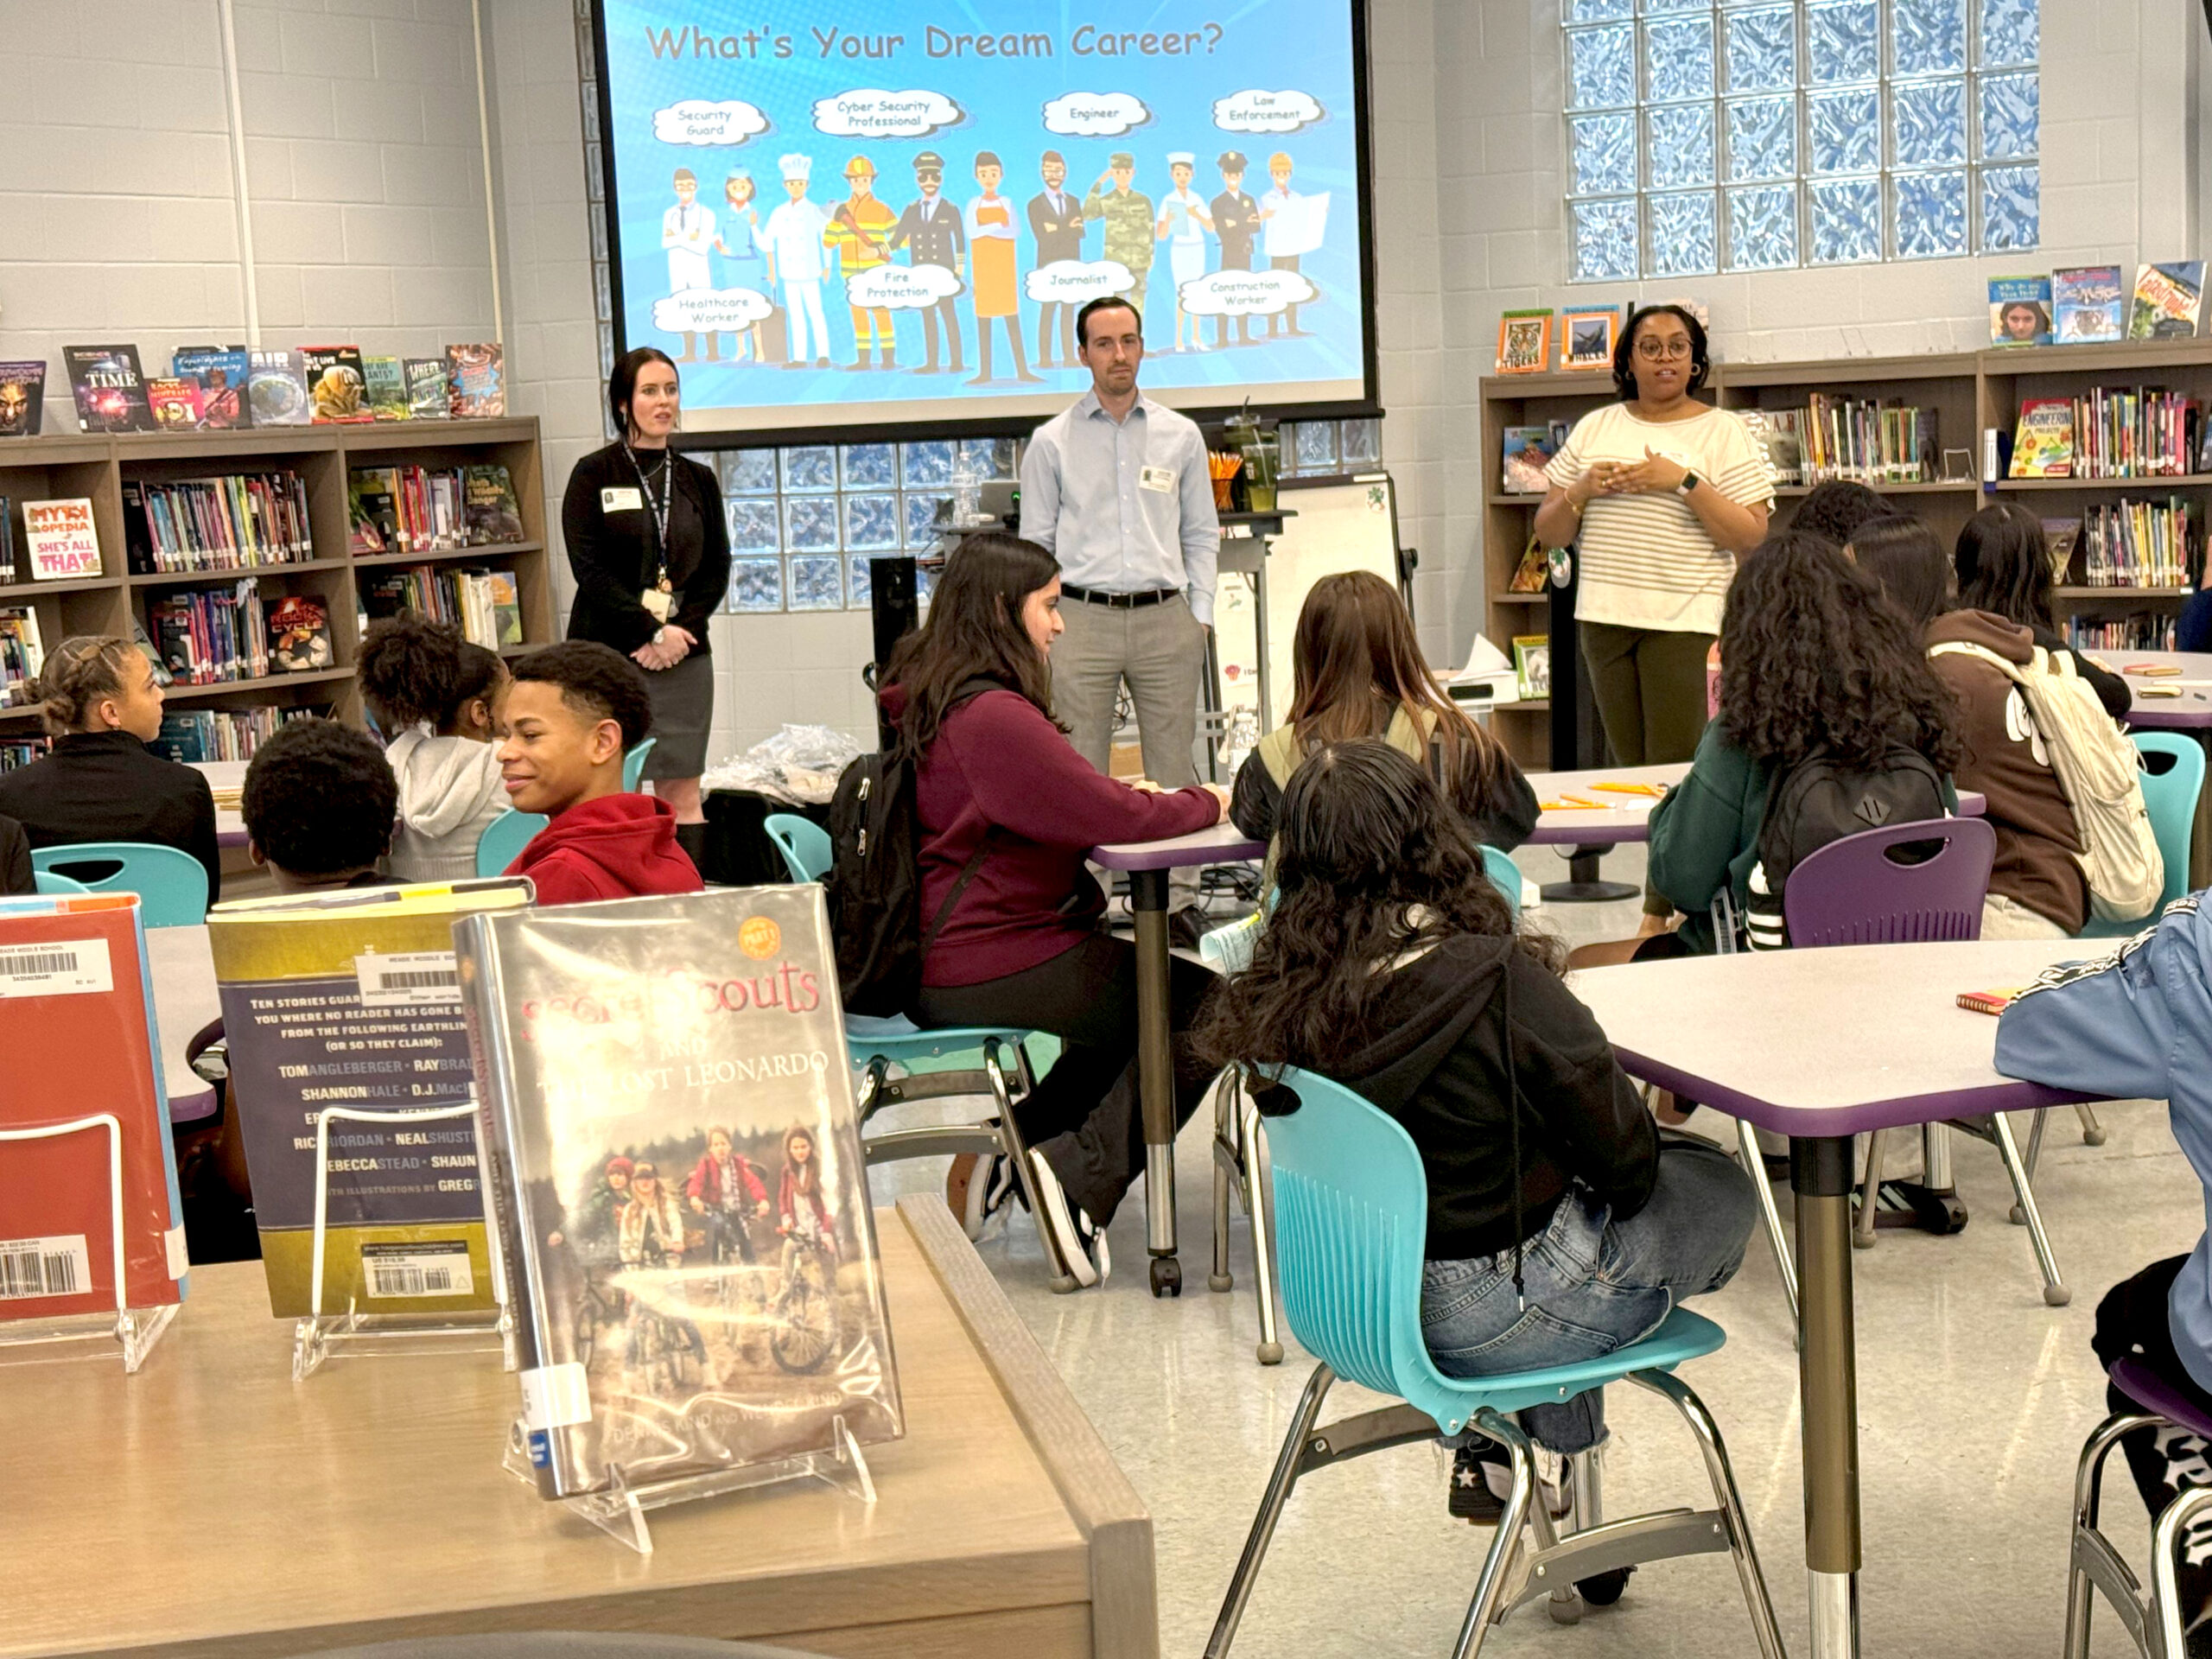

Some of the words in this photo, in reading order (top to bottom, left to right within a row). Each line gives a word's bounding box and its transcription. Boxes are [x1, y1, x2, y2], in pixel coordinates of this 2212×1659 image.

[645, 24, 793, 60] What's
[810, 25, 906, 59] Your
[925, 24, 1053, 58] Dream
[1071, 22, 1224, 56] Career?
[836, 100, 874, 114] Cyber
[878, 100, 931, 113] Security
[1253, 95, 1275, 106] Law
[677, 109, 732, 124] Security
[848, 115, 921, 127] Professional
[1069, 108, 1121, 121] Engineer
[1228, 109, 1300, 121] Enforcement
[686, 124, 725, 136] Guard
[884, 271, 909, 283] Fire
[1050, 274, 1108, 285] Journalist
[867, 286, 929, 298] Protection
[1210, 280, 1281, 293] Construction
[678, 296, 749, 309] Healthcare
[1224, 295, 1268, 306] Worker
[691, 311, 739, 324] Worker
[85, 371, 139, 388] TIME
[37, 541, 69, 553] SHE'S
[72, 540, 94, 551] ALL
[271, 620, 322, 633] CYCLE
[250, 999, 275, 1009] TEN
[276, 997, 327, 1008] STORIES
[328, 995, 360, 1005] GUAR
[254, 1014, 279, 1025] YOU
[281, 1012, 323, 1023] WHERE
[325, 1011, 342, 1020] NO
[345, 1007, 391, 1020] READER
[394, 1007, 418, 1017] HAS
[420, 1006, 452, 1016] GONE
[281, 1027, 315, 1039] FROM
[316, 1027, 340, 1037] THE
[342, 1023, 409, 1035] FOLLOWING
[410, 1021, 468, 1033] EARTHLIN
[325, 1040, 346, 1053] (OR
[349, 1040, 365, 1050] SO
[366, 1039, 397, 1049] THEY
[398, 1036, 443, 1049] CLAIM):
[658, 1036, 709, 1062] AND
[607, 1067, 674, 1096] LOST
[684, 1050, 830, 1088] LEONARDO
[431, 1154, 477, 1168] SHAUN
[346, 1184, 422, 1197] ILLUSTRATIONS
[423, 1184, 436, 1193] BY
